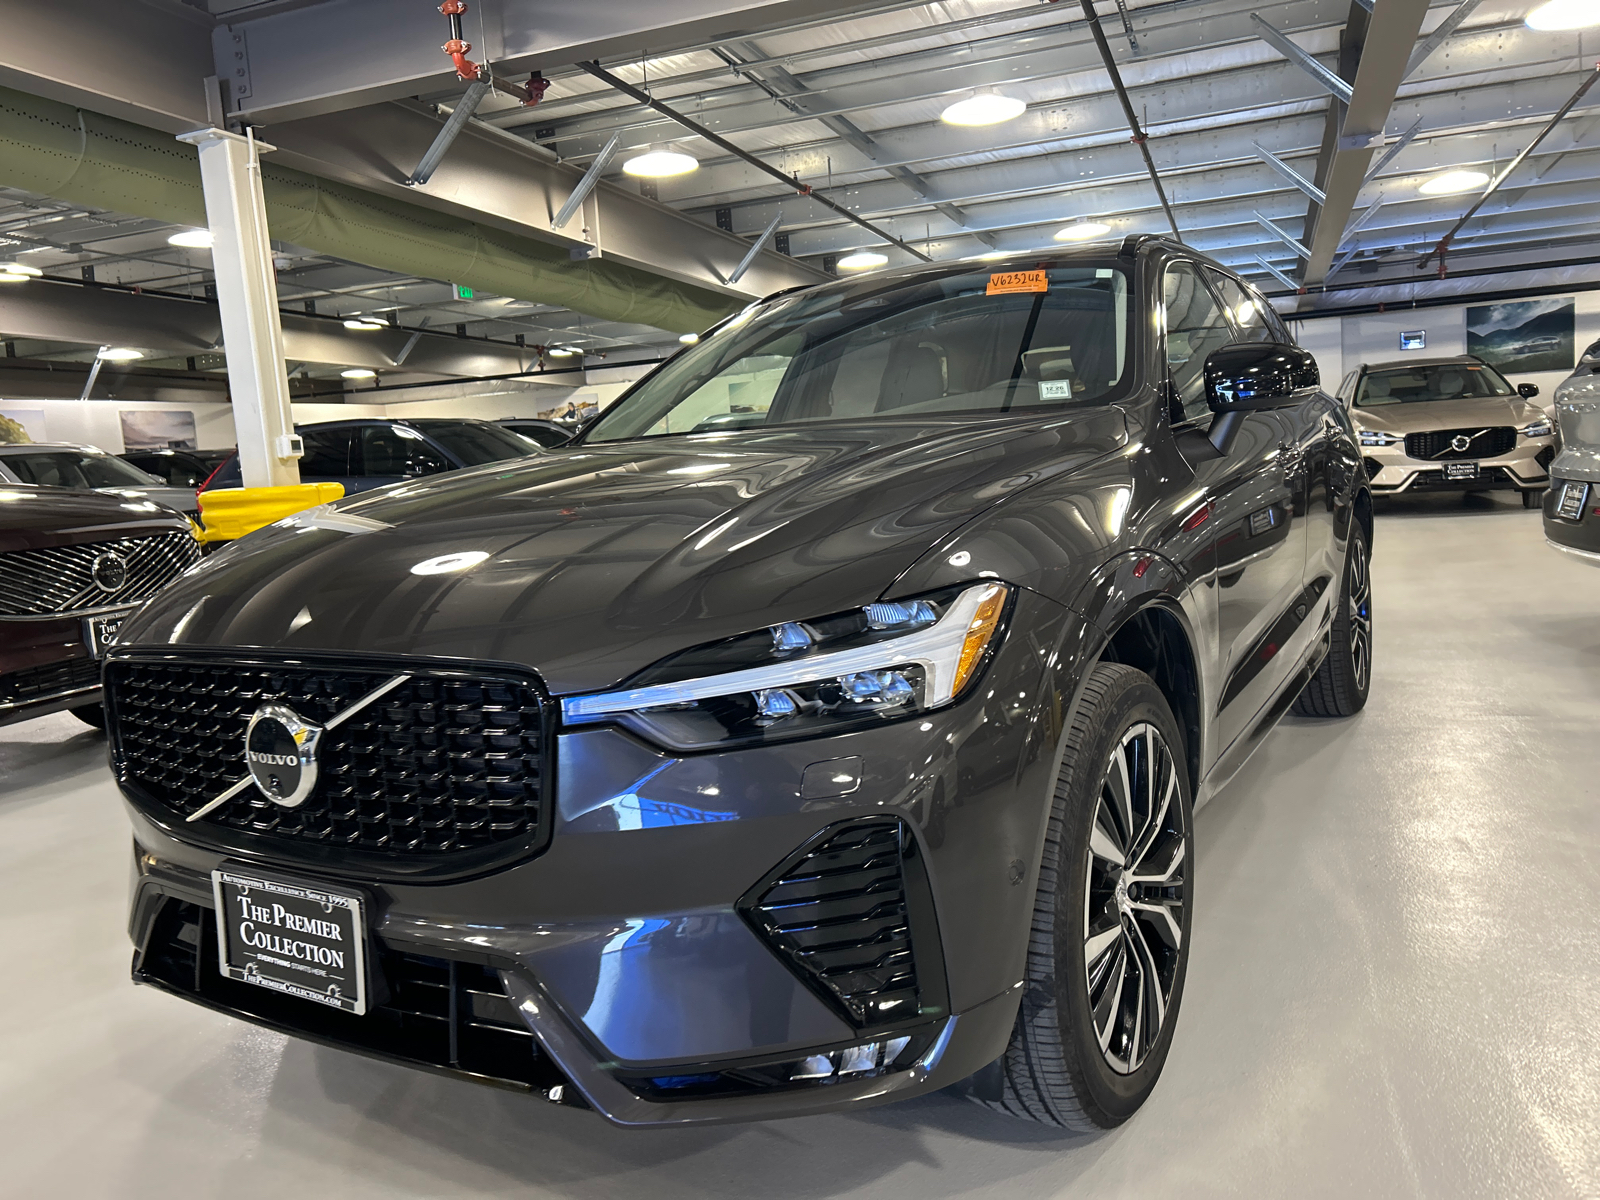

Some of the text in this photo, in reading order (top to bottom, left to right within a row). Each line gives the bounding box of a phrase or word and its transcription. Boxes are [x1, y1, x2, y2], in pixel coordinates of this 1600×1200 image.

[99, 624, 117, 634] THE
[249, 751, 298, 766] VOLVO
[237, 895, 343, 941] THE PREMIER
[240, 921, 344, 969] COLLECTION
[256, 953, 291, 968] EVERYTHING
